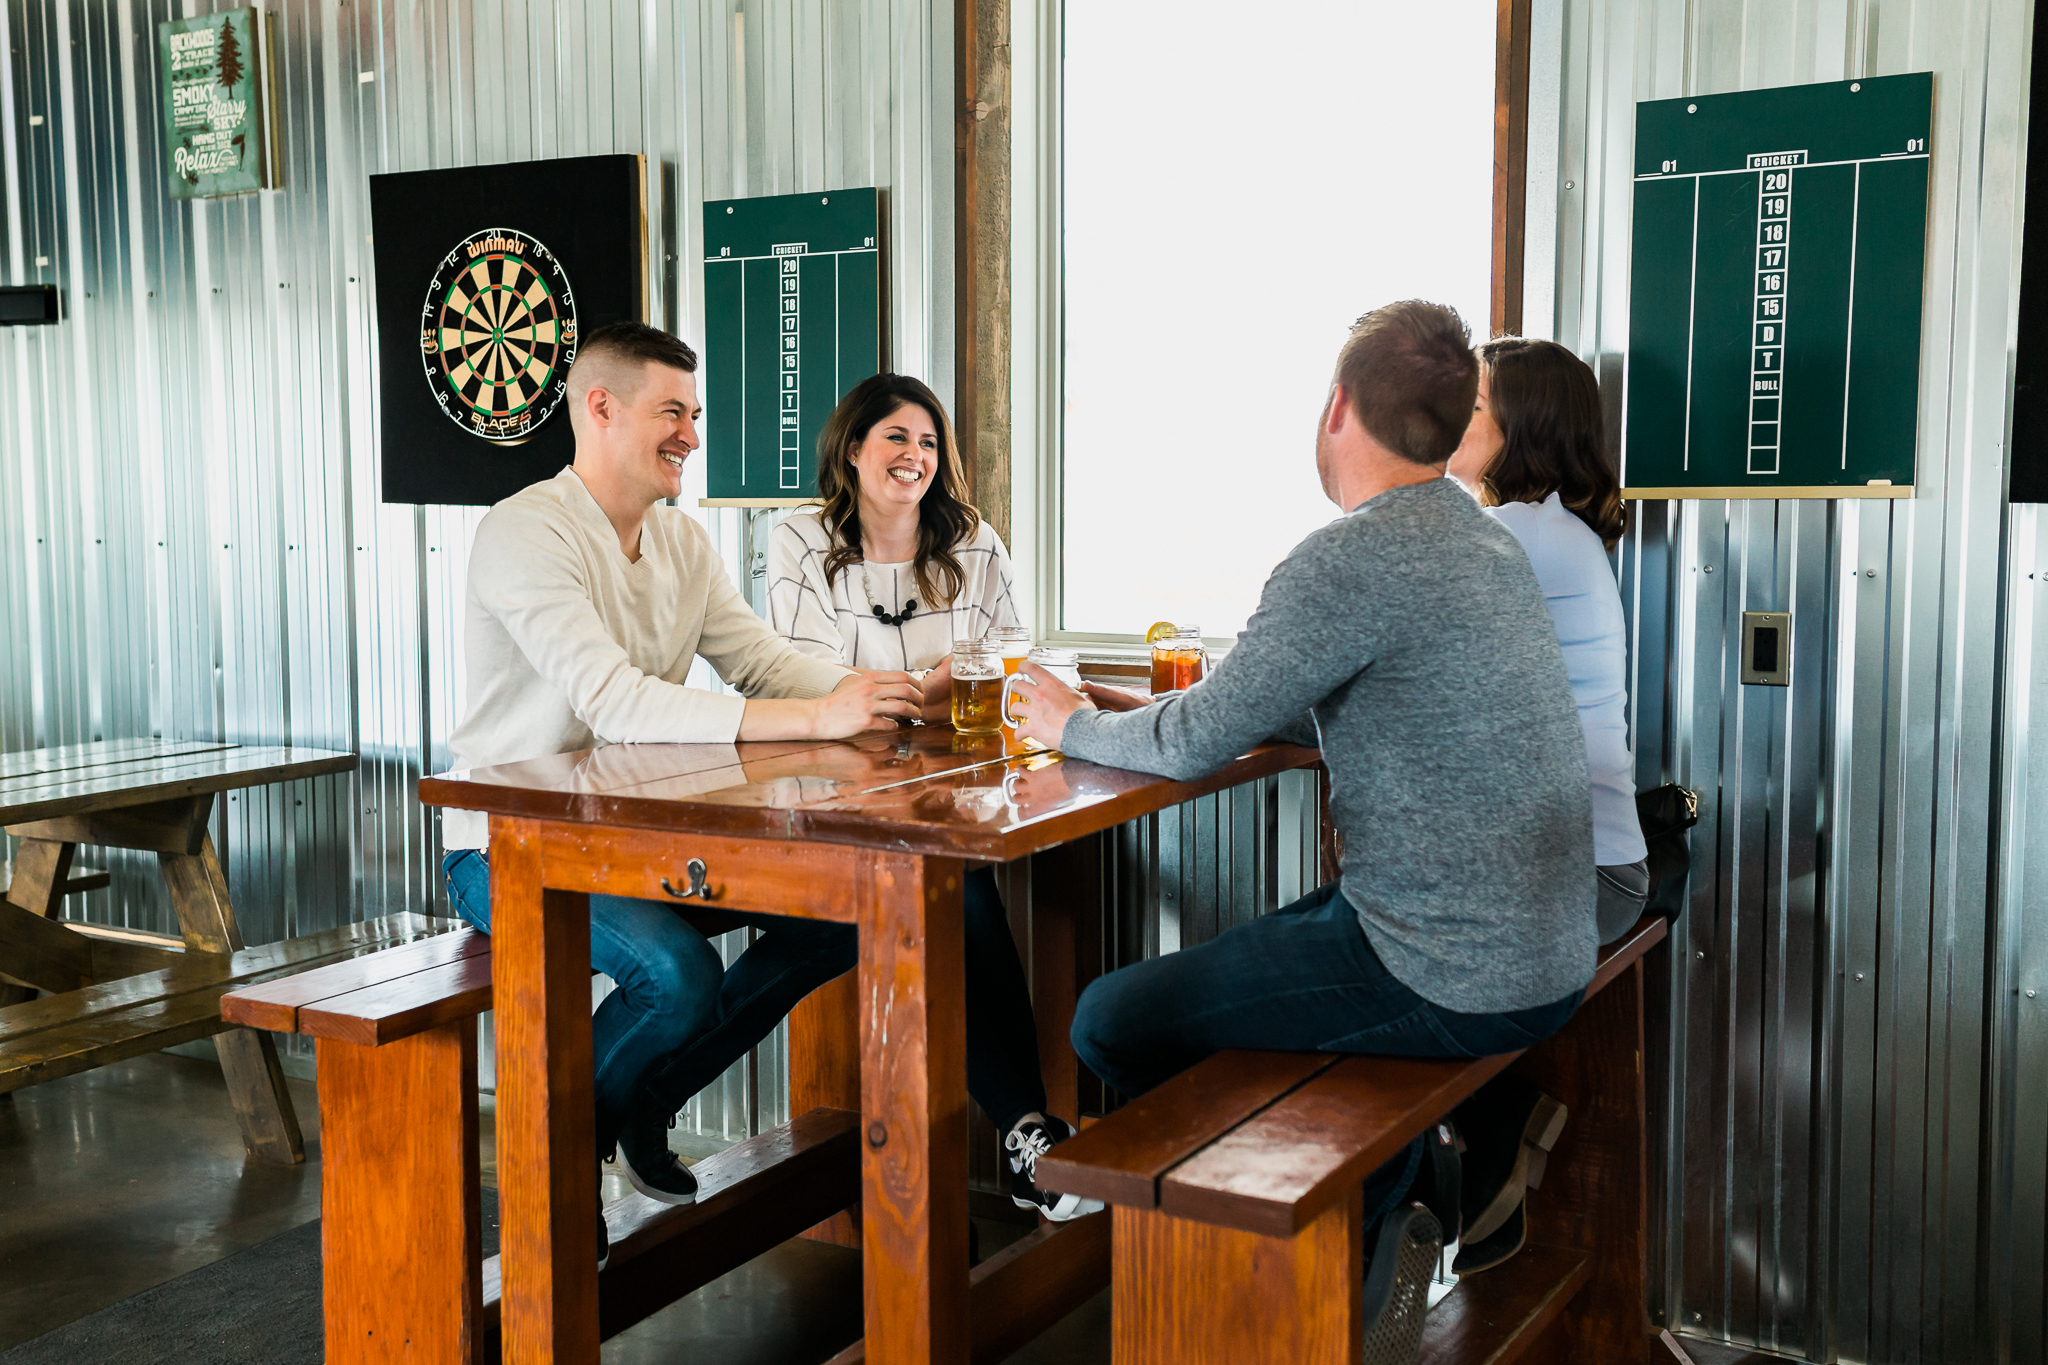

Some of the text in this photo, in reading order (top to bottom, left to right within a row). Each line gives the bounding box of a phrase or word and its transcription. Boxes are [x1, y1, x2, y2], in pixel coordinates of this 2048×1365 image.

[172, 83, 215, 107] SMOKY
[207, 95, 246, 123] Starry
[213, 115, 238, 130] SKY
[192, 130, 233, 146] HANG OUT
[1907, 138, 1924, 152] 01
[174, 147, 234, 180] Relax
[1661, 160, 1677, 173] 01
[1753, 154, 1800, 168] CRICKET
[1765, 173, 1787, 191] 20
[1764, 198, 1785, 216] 19
[1763, 224, 1783, 242] 18
[864, 236, 874, 247] 01
[721, 246, 731, 257] 01
[775, 245, 803, 255] CRICKET
[1763, 249, 1782, 267] 17
[783, 259, 797, 273] 20
[783, 278, 796, 292] 19
[1762, 274, 1781, 291] 16
[784, 298, 796, 312] 18
[1761, 299, 1780, 316] 15
[784, 317, 796, 331] 17
[1762, 326, 1775, 343] D
[784, 336, 796, 349] 16
[784, 355, 796, 368] 15
[1762, 351, 1774, 368] T
[786, 375, 794, 388] D
[1754, 379, 1779, 391] BULL
[786, 394, 794, 408] T
[782, 416, 797, 425] BULL
